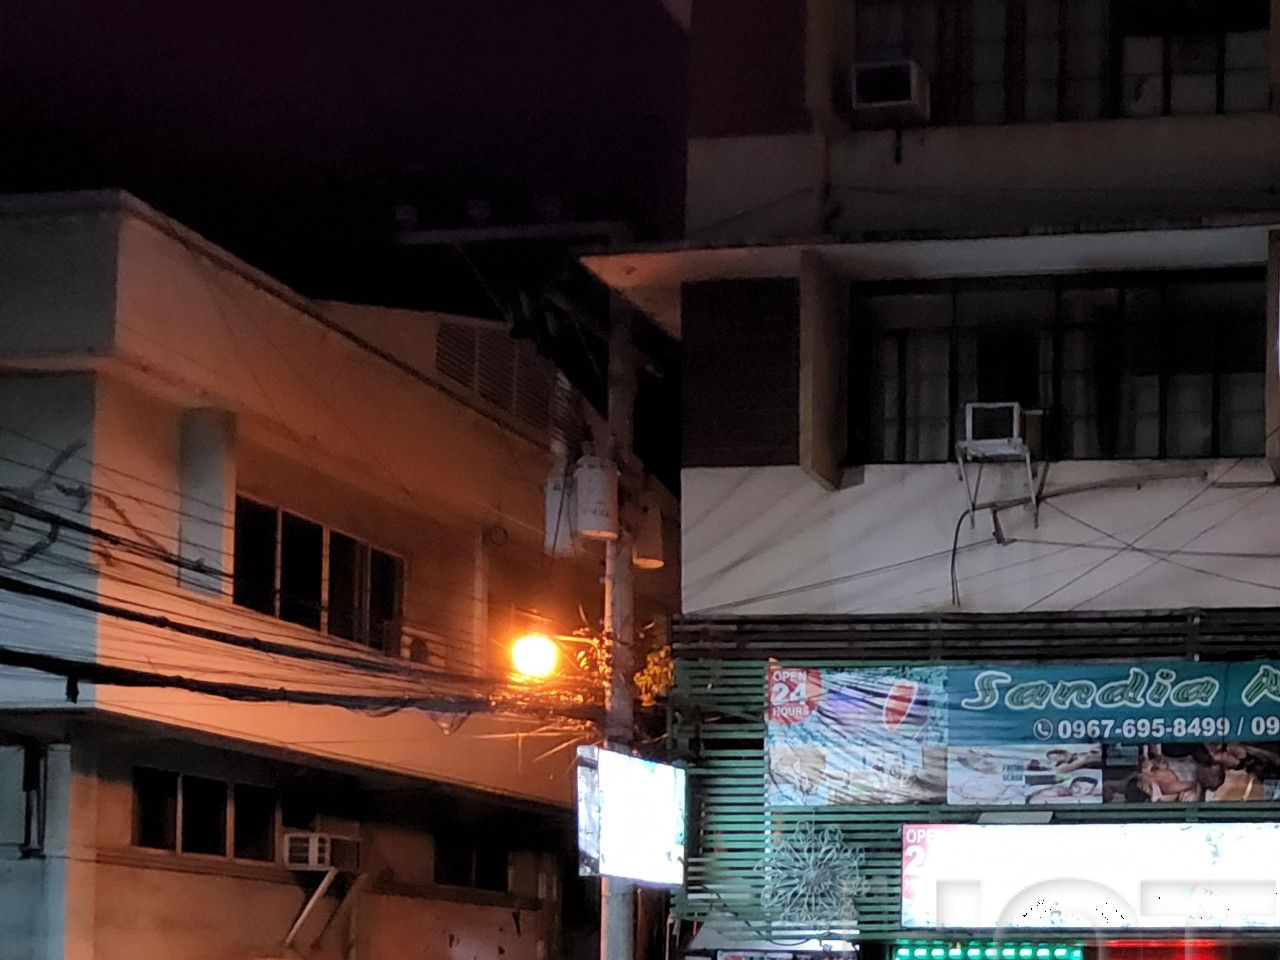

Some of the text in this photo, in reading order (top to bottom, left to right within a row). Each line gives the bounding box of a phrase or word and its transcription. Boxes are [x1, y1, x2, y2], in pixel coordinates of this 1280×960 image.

[773, 671, 807, 682] OPEN
[770, 681, 807, 706] 24
[962, 667, 1219, 710] Sandia
[772, 706, 809, 717] HOURS
[1057, 717, 1231, 739] 0967-695-8499
